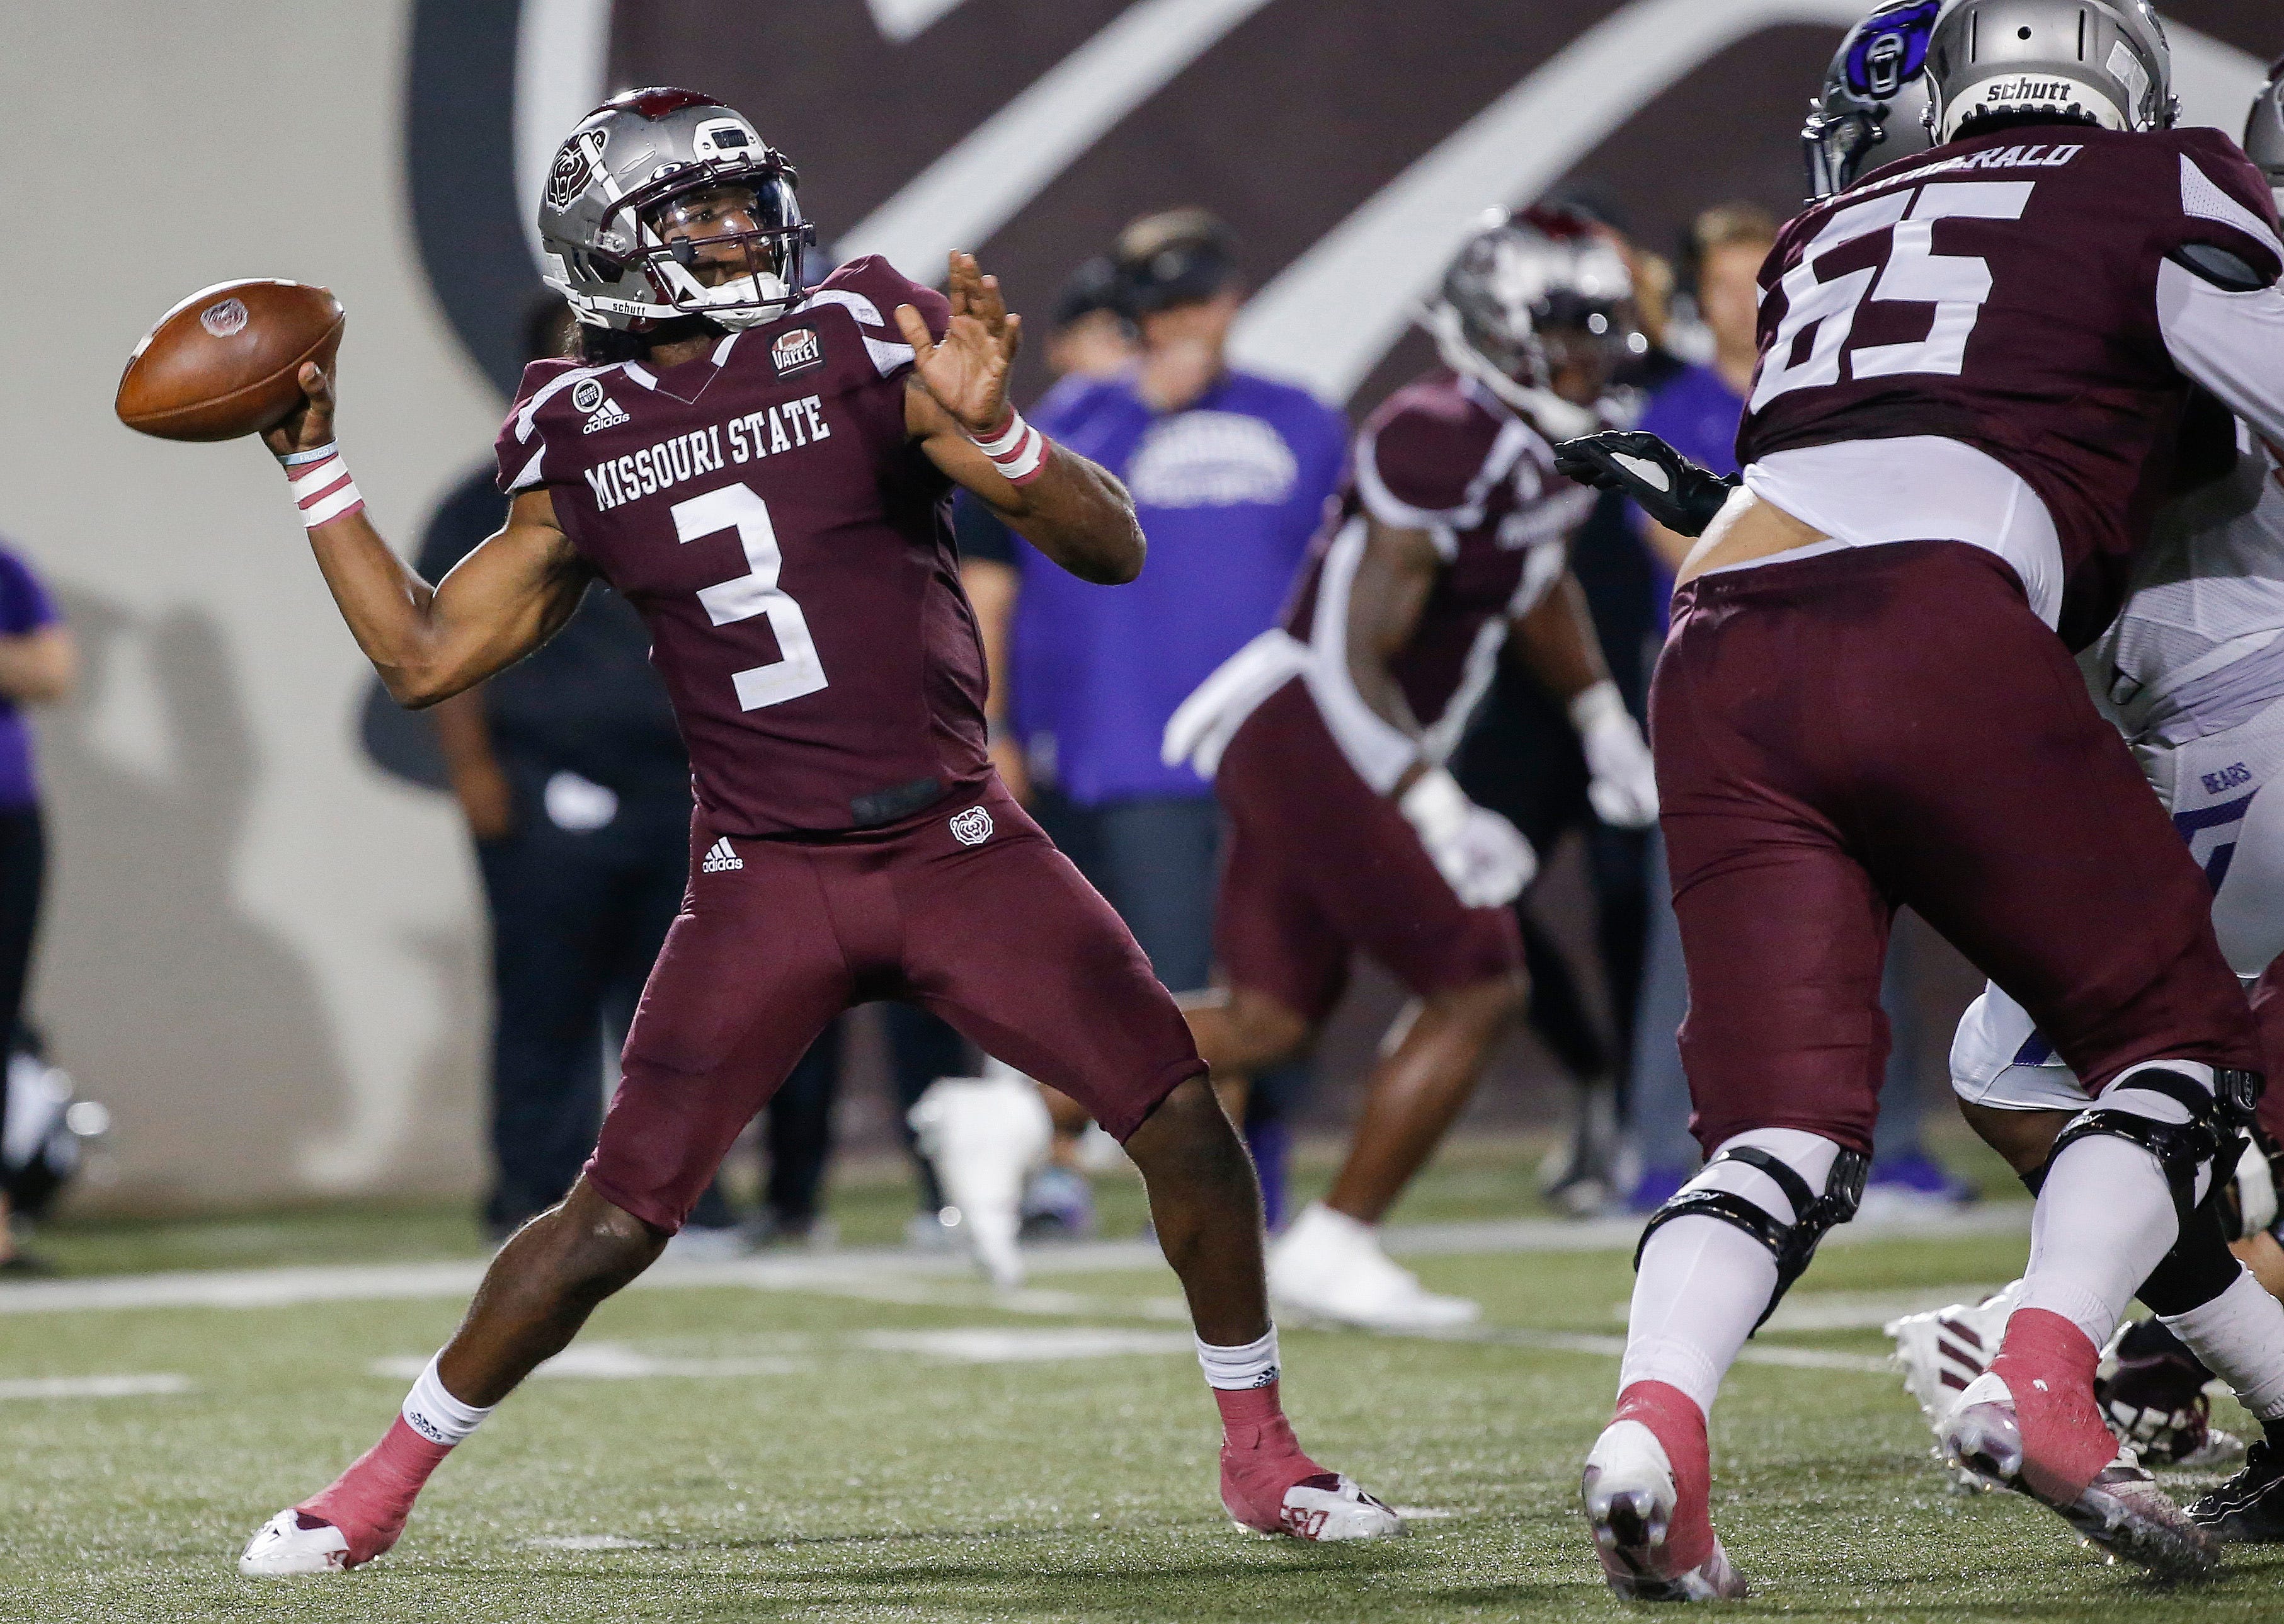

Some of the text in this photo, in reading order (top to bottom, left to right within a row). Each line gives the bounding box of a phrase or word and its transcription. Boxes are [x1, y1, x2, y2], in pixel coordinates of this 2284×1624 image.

[1987, 76, 2071, 102] schutt
[612, 302, 646, 315] schutt
[1750, 180, 2036, 416] 65
[771, 335, 819, 370] VALLEY
[582, 413, 631, 435] adidas
[583, 393, 831, 512] MISSOURI STATE
[669, 481, 830, 712] 3
[702, 856, 744, 873] adidas
